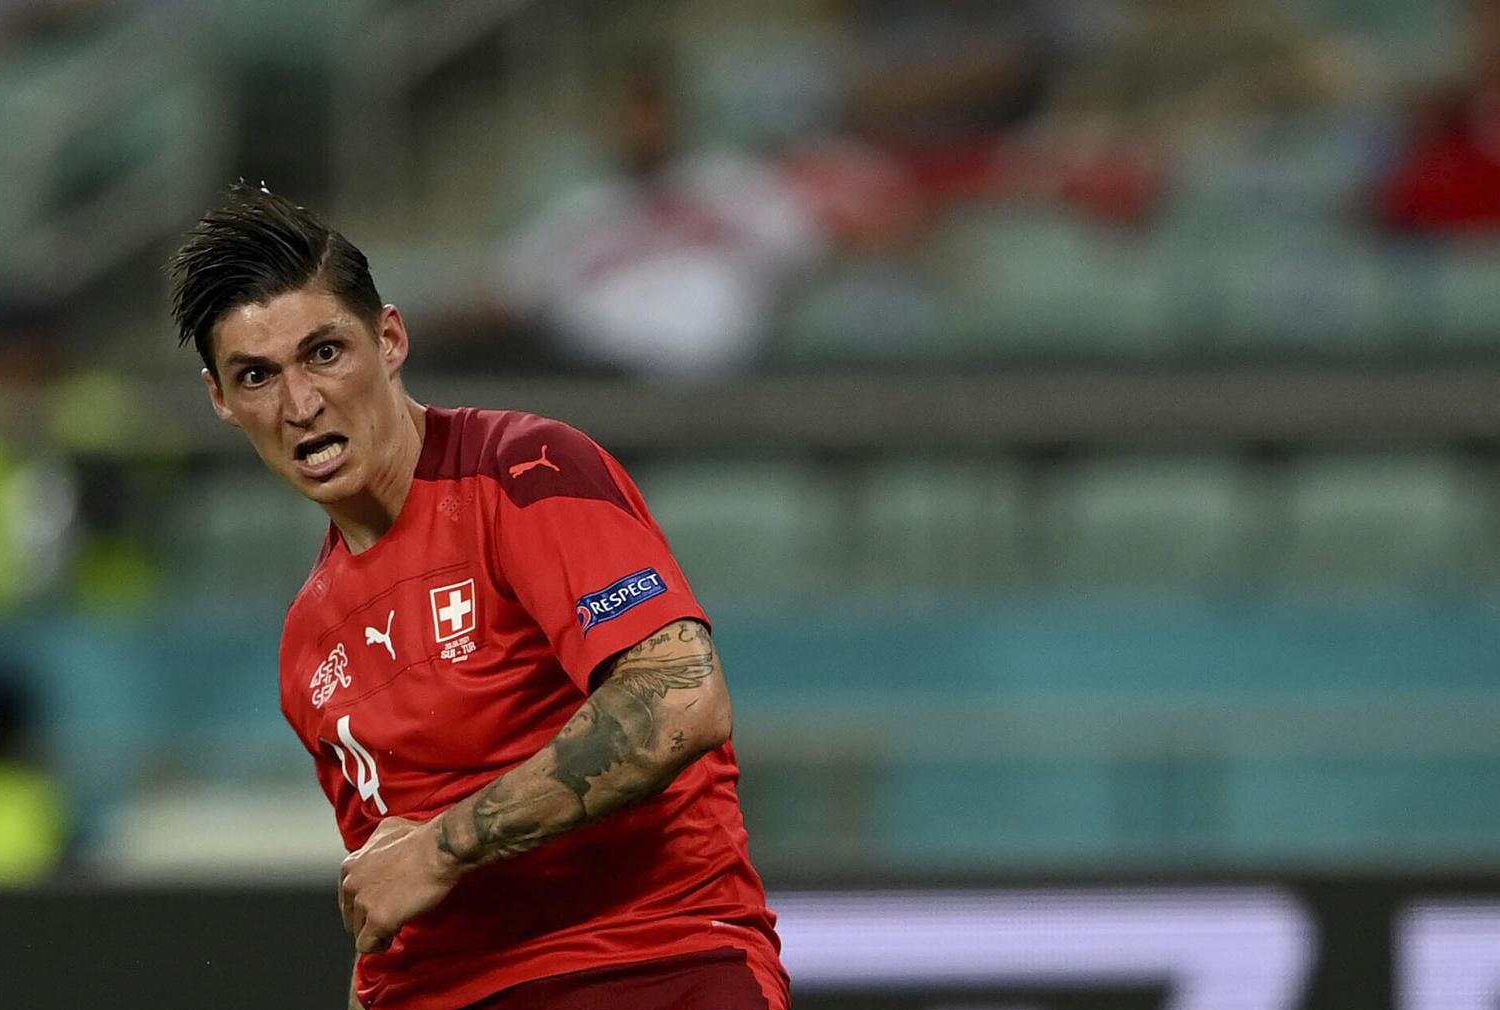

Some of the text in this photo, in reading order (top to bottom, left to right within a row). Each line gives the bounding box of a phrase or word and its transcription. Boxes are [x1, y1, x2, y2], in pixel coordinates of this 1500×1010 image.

[589, 573, 659, 615] RESPECT
[440, 648, 456, 659] SUI
[461, 641, 477, 655] TUR
